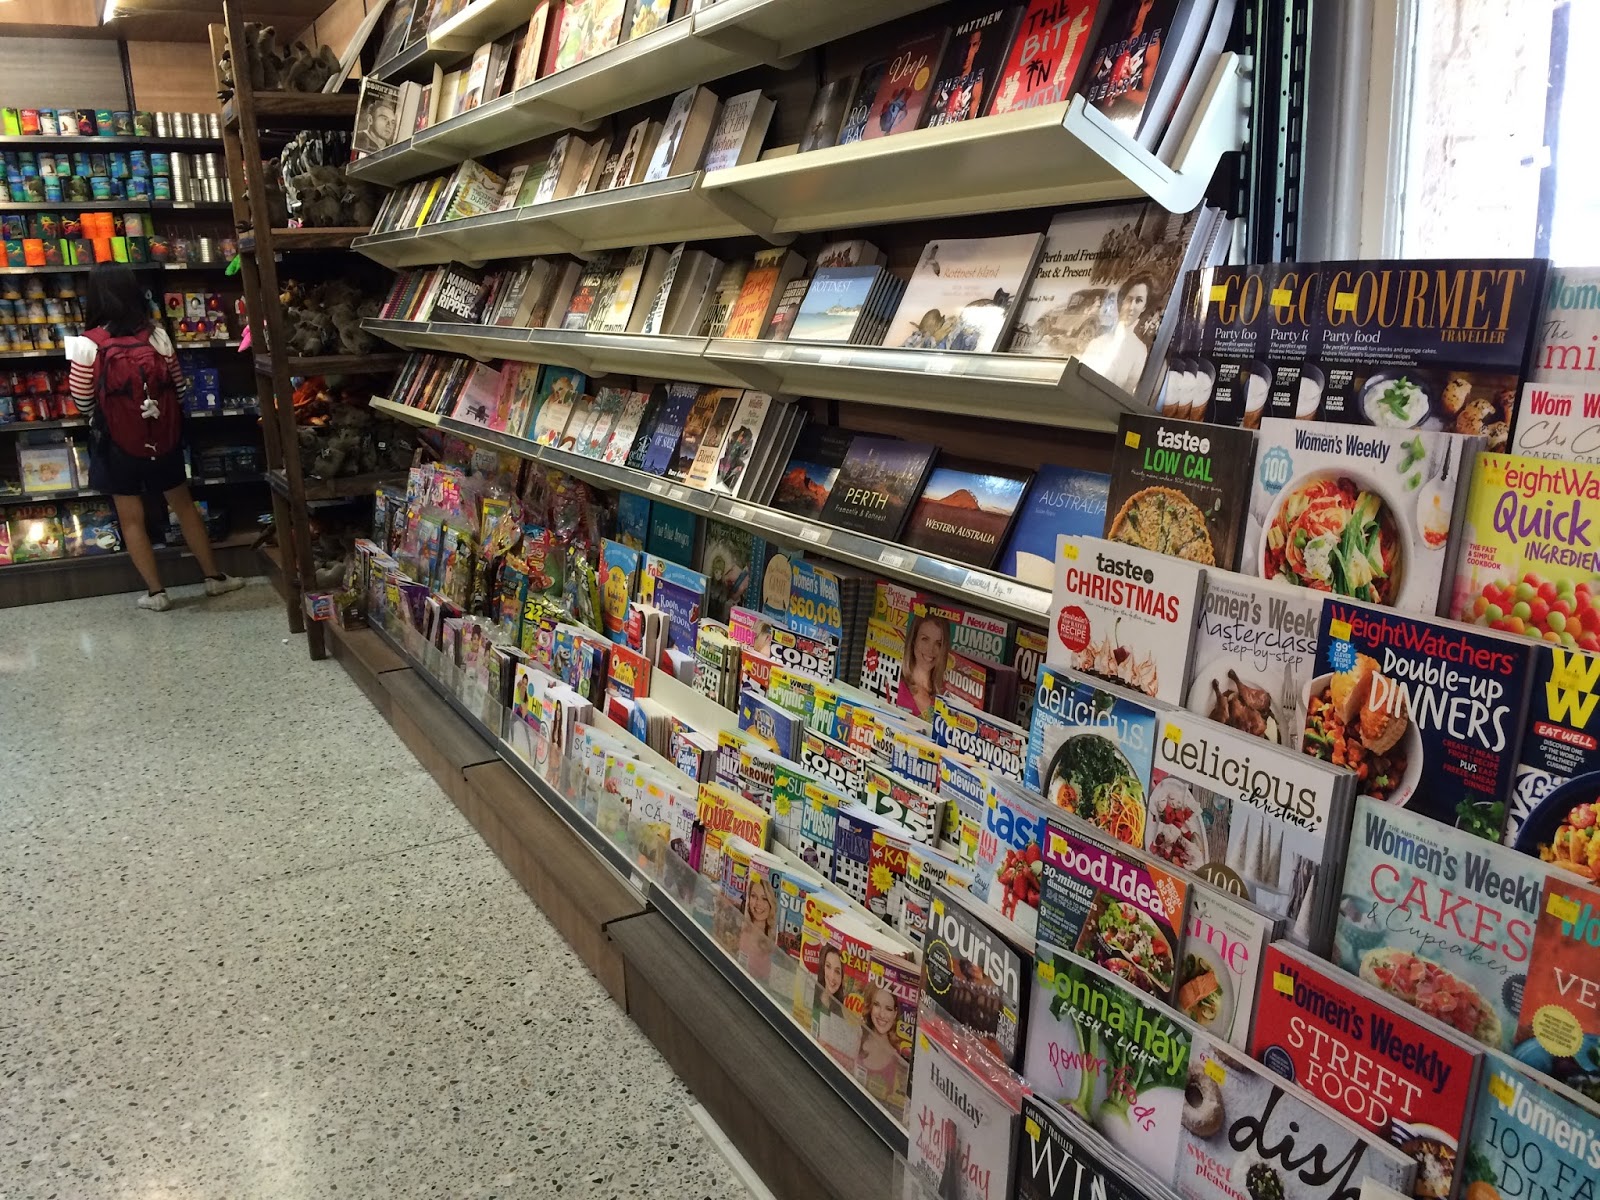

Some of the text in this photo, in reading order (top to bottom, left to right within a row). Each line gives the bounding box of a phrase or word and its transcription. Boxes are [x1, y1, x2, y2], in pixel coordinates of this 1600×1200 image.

[956, 9, 1004, 36] MATTHEW
[1028, 0, 1069, 34] THE
[1095, 27, 1162, 66] PURPLE
[936, 67, 985, 93] PURPLE
[1089, 72, 1142, 103] HEART
[927, 104, 970, 129] HEART
[977, 264, 1000, 279] Island
[1035, 265, 1093, 280] Past & Present
[1041, 251, 1062, 264] Perth
[1063, 250, 1080, 263] and
[441, 286, 467, 304] JACK
[446, 272, 481, 296] NAMING
[811, 280, 853, 294] ROTTNEST
[1324, 268, 1527, 331] GOURMET
[436, 294, 472, 319] RIPPER
[1216, 273, 1264, 327] GO
[732, 318, 755, 336] JANE
[1214, 327, 1258, 342] Party foo
[1270, 328, 1301, 344] Party
[1322, 329, 1381, 346] Party food
[1439, 328, 1506, 345] TRAVELLER
[1544, 319, 1574, 340] The
[1156, 426, 1203, 454] taste
[1294, 427, 1391, 464] Women's Weekly
[1143, 447, 1181, 476] LOW
[1183, 454, 1214, 483] CAL
[1263, 457, 1288, 484] 100
[1484, 457, 1600, 500] eightWa
[834, 503, 887, 523] Fremantle Rottnest
[843, 486, 889, 511] PERTH
[1038, 489, 1108, 516] AUSTRALIA
[925, 517, 995, 546] WESTERN AUSTRALIA
[1492, 490, 1593, 548] Quick
[1466, 557, 1502, 571] COOKBOOK
[1469, 543, 1498, 555] THE FAST
[1474, 552, 1496, 562] SIMPLE
[1524, 542, 1600, 575] INGREDIEN
[1095, 552, 1145, 583] taste
[1066, 567, 1181, 624] CHRISTMAS
[1219, 587, 1249, 599] AUSTRALIAN
[789, 593, 841, 629] $60,019
[929, 606, 961, 622] PUZZLES
[966, 615, 1005, 636] New Idea
[1267, 596, 1323, 640] Week
[952, 625, 1004, 656] JUMBO
[1060, 624, 1087, 640] RECIPE
[1331, 604, 1515, 676] WeightWatchers
[770, 642, 830, 675] CODE
[1221, 639, 1304, 673] step-by-step
[943, 668, 984, 700] SUDOKU
[1382, 647, 1504, 709] Double-up
[1035, 708, 1065, 730] TRENDING
[1367, 670, 1510, 753] DINNERS
[944, 728, 1021, 775] CROSSWORD
[1538, 725, 1594, 749] EAT WELL
[1543, 739, 1583, 756] DISCOVER ONE
[1459, 760, 1498, 779] PLUS EASY
[1474, 757, 1500, 771] RECIPE
[1476, 748, 1500, 761] MEALS
[1544, 753, 1578, 769] HEALTHIEST
[1548, 747, 1559, 757] THE
[1559, 751, 1585, 764] WORLD'S
[800, 750, 859, 791] CODE
[1160, 731, 1325, 823] delicious.
[1463, 779, 1497, 796] DINNERS
[1240, 786, 1320, 834] christmas
[1365, 812, 1459, 883] Women's
[1388, 824, 1439, 849] THE AUSTRALIAN
[1042, 863, 1094, 899] 30-minute
[1046, 830, 1170, 921] Food Idea
[1046, 878, 1099, 912] dinner winners
[1370, 862, 1532, 964] CAKES
[927, 900, 1020, 1003] nourish
[1385, 904, 1515, 977] Cupcakes
[1037, 959, 1126, 1031] donna
[1132, 1006, 1188, 1077] hay
[1279, 962, 1366, 1041] Women's
[1369, 1012, 1453, 1094] Weekly
[1058, 1000, 1159, 1068] FRESH LIGHT
[1047, 1040, 1109, 1088] power
[1286, 1015, 1423, 1116] STREET
[929, 1061, 986, 1129] Halliday
[1305, 1059, 1389, 1128] FOOD
[1484, 1116, 1544, 1175] 100
[1185, 1140, 1232, 1184] sweet
